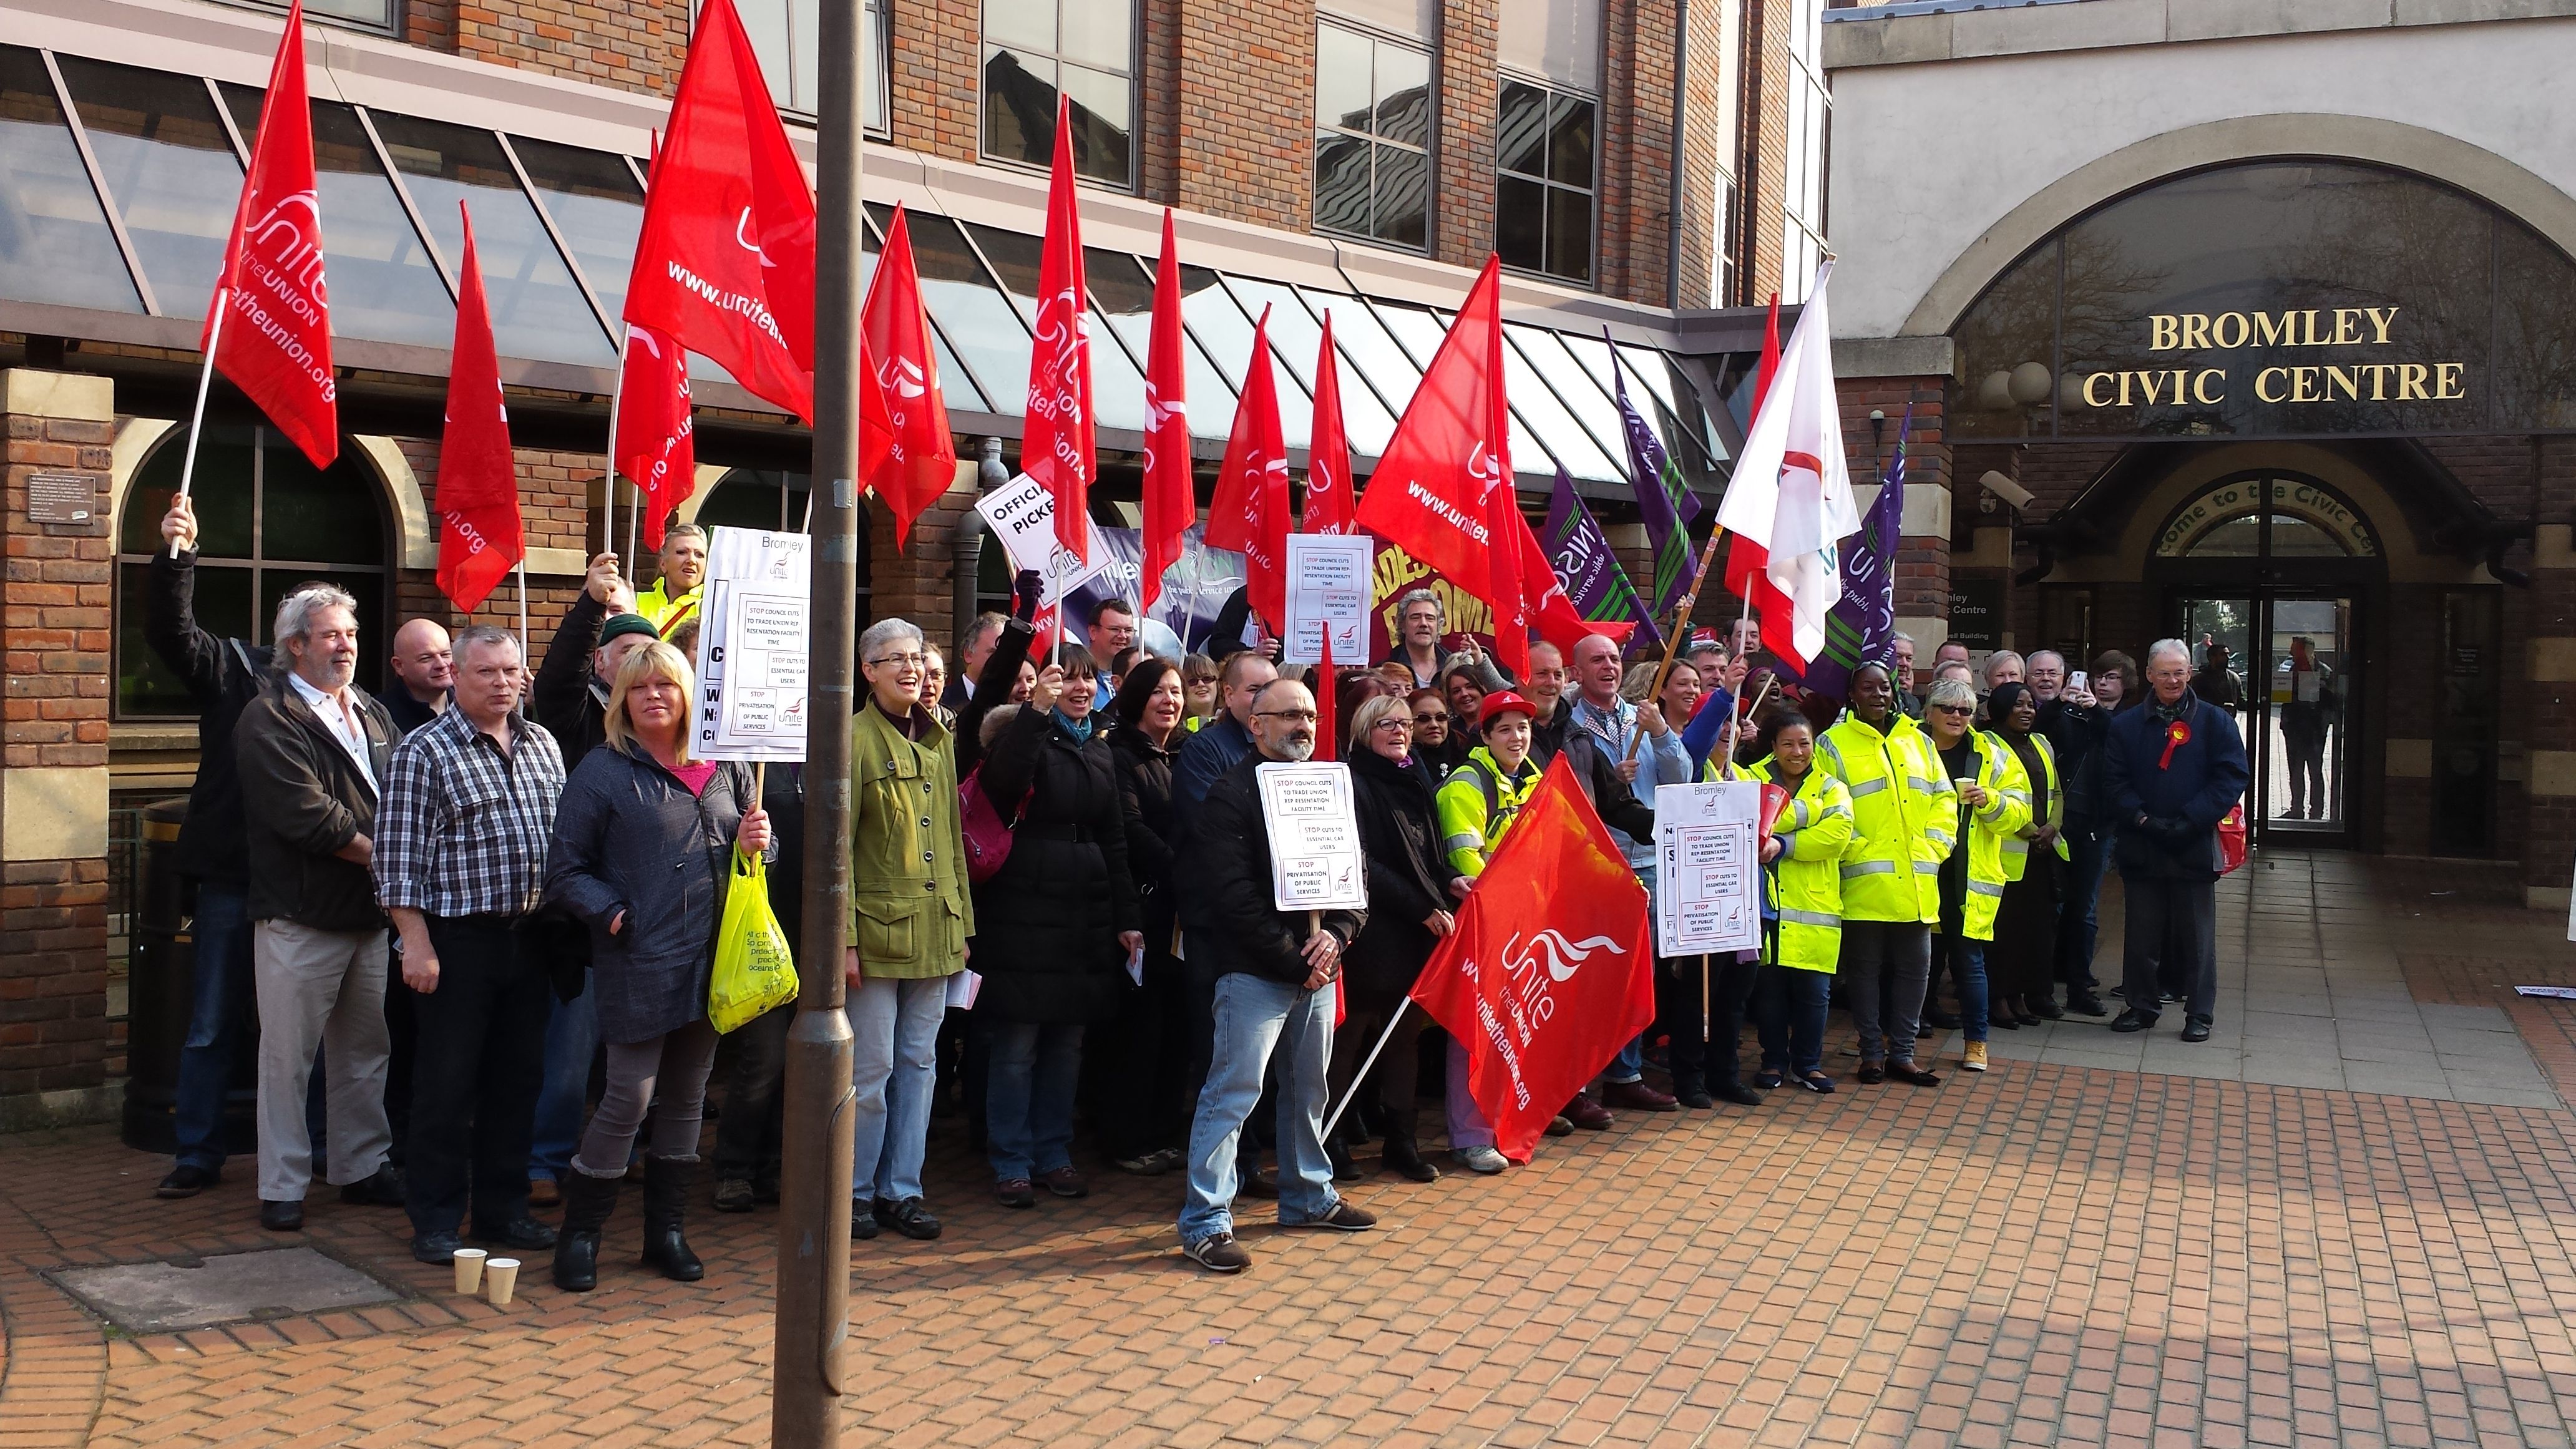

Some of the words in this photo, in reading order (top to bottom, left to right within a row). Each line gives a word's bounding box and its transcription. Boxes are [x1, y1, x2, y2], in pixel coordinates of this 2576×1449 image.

[2149, 306, 2399, 351] BROMLEY
[2082, 368, 2227, 407] CIVIC
[2254, 362, 2466, 403] CENTRE
[2212, 490, 2238, 507] to
[2247, 483, 2286, 499] te
[2295, 484, 2349, 522] Civic
[1012, 499, 1055, 535] PICKE
[762, 536, 803, 553] Bromley
[1953, 605, 1987, 613] Centre
[1960, 632, 1989, 640] Building
[1694, 786, 1726, 796] Bromley
